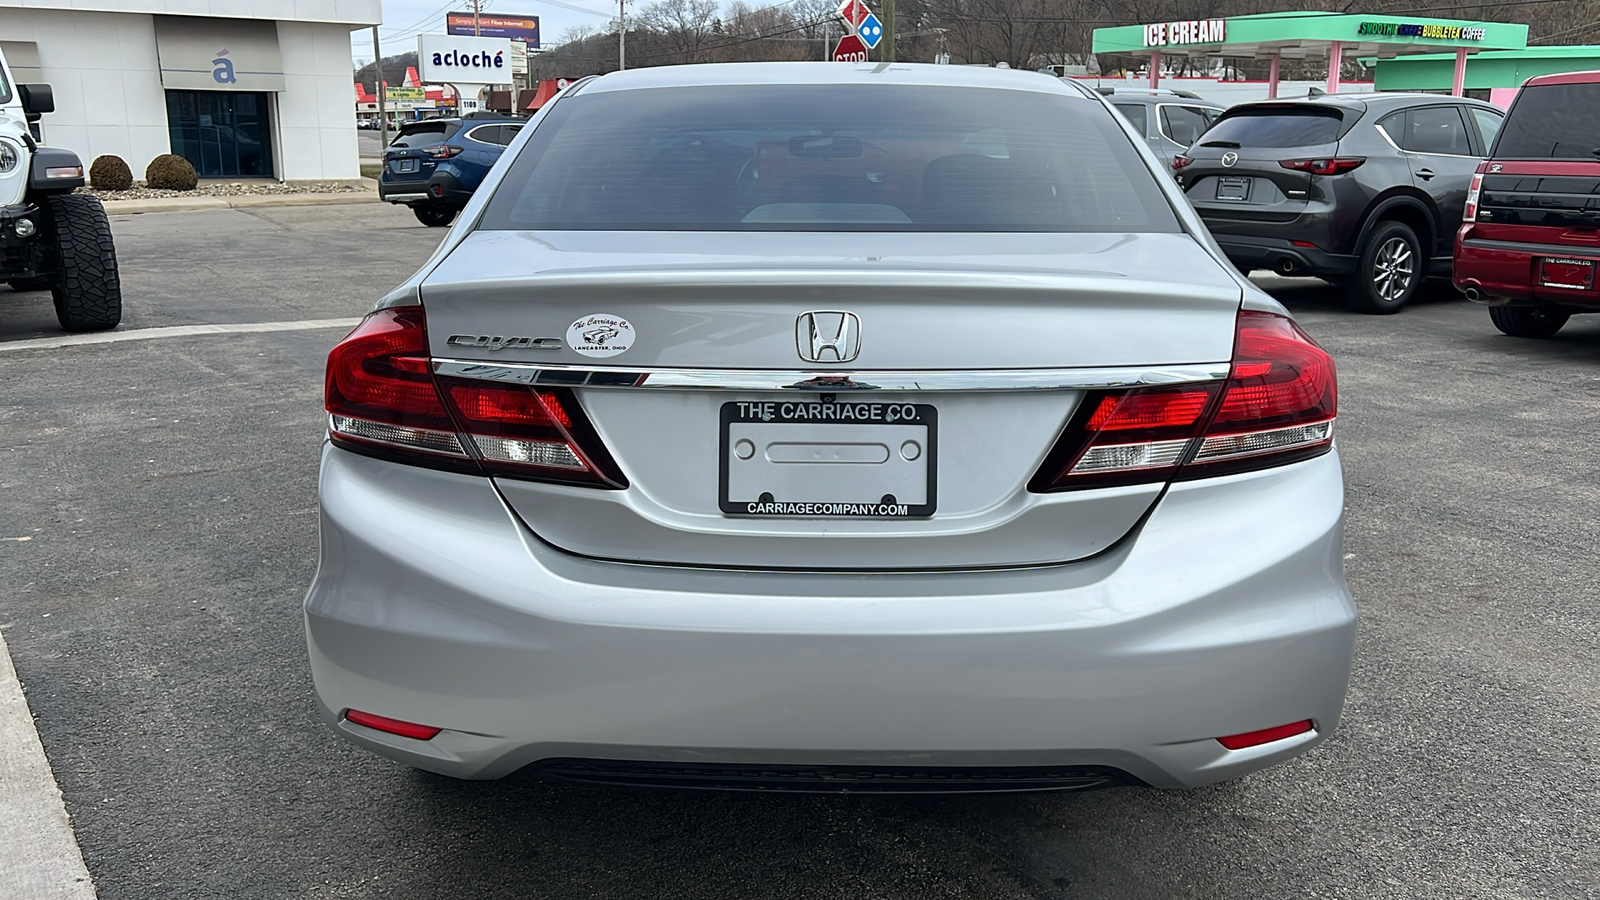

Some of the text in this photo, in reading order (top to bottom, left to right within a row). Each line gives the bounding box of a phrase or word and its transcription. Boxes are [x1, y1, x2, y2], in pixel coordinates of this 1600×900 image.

[1143, 20, 1225, 47] ICE CREAM
[1461, 27, 1486, 40] COFFEE
[432, 49, 503, 68] acloché
[836, 51, 865, 62] STOP
[573, 317, 631, 331] The Carriage Co.
[446, 334, 563, 352] CIVIC
[736, 402, 921, 421] THE CARRIAGE CO.
[747, 502, 909, 516] CARRIAGECOMPANY.COM
